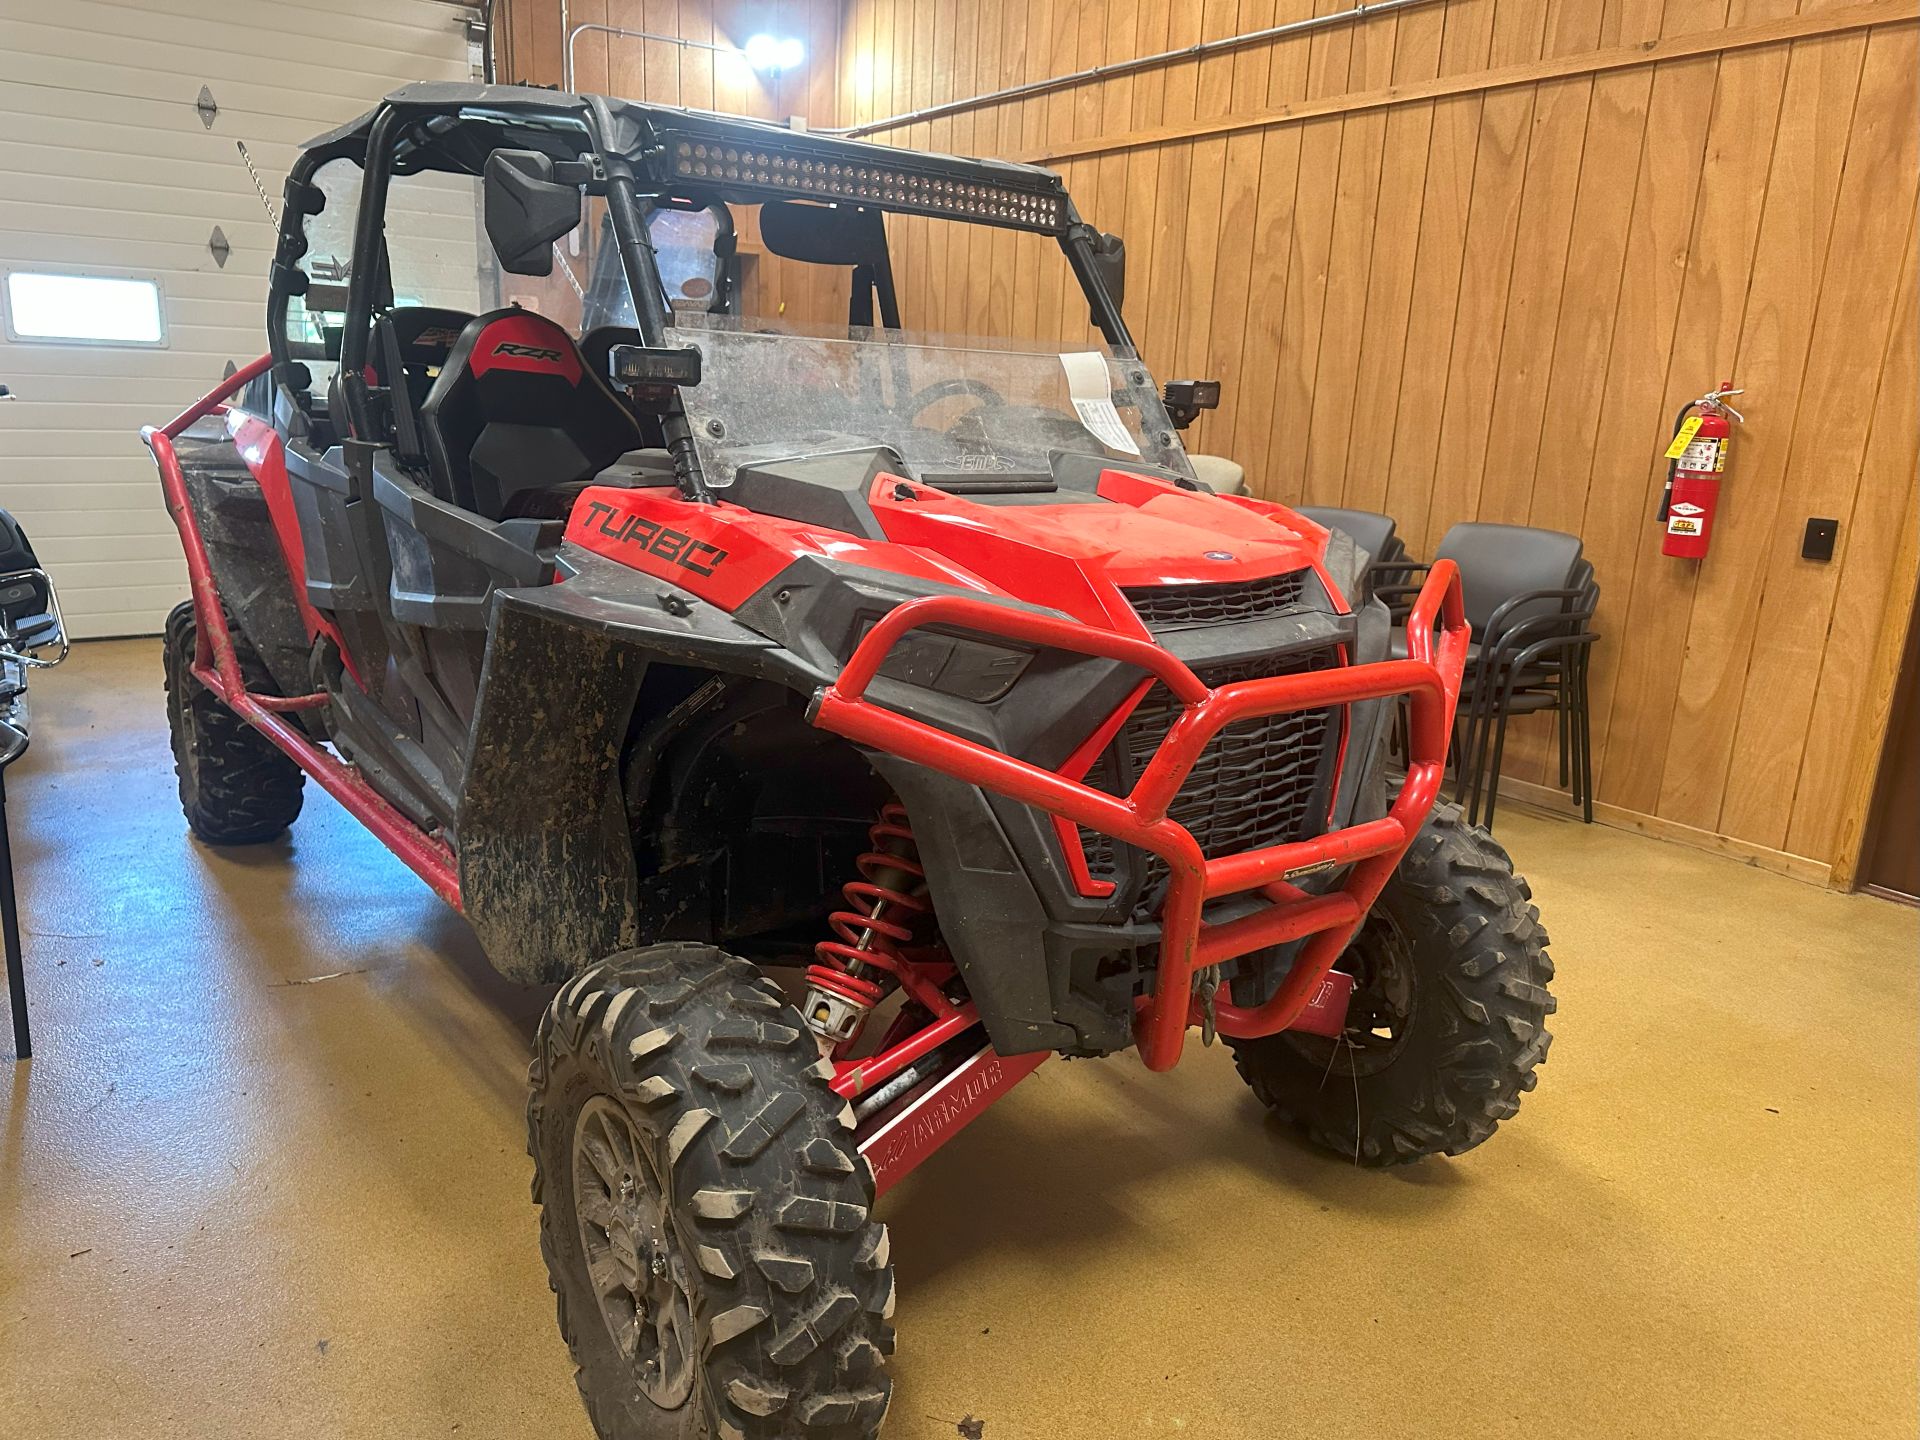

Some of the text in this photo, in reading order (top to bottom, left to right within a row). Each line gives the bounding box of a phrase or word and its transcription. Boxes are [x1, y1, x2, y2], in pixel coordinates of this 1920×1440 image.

[491, 341, 563, 362] RZR
[583, 501, 729, 577] TURBO
[912, 1060, 1003, 1149] ARMOR
